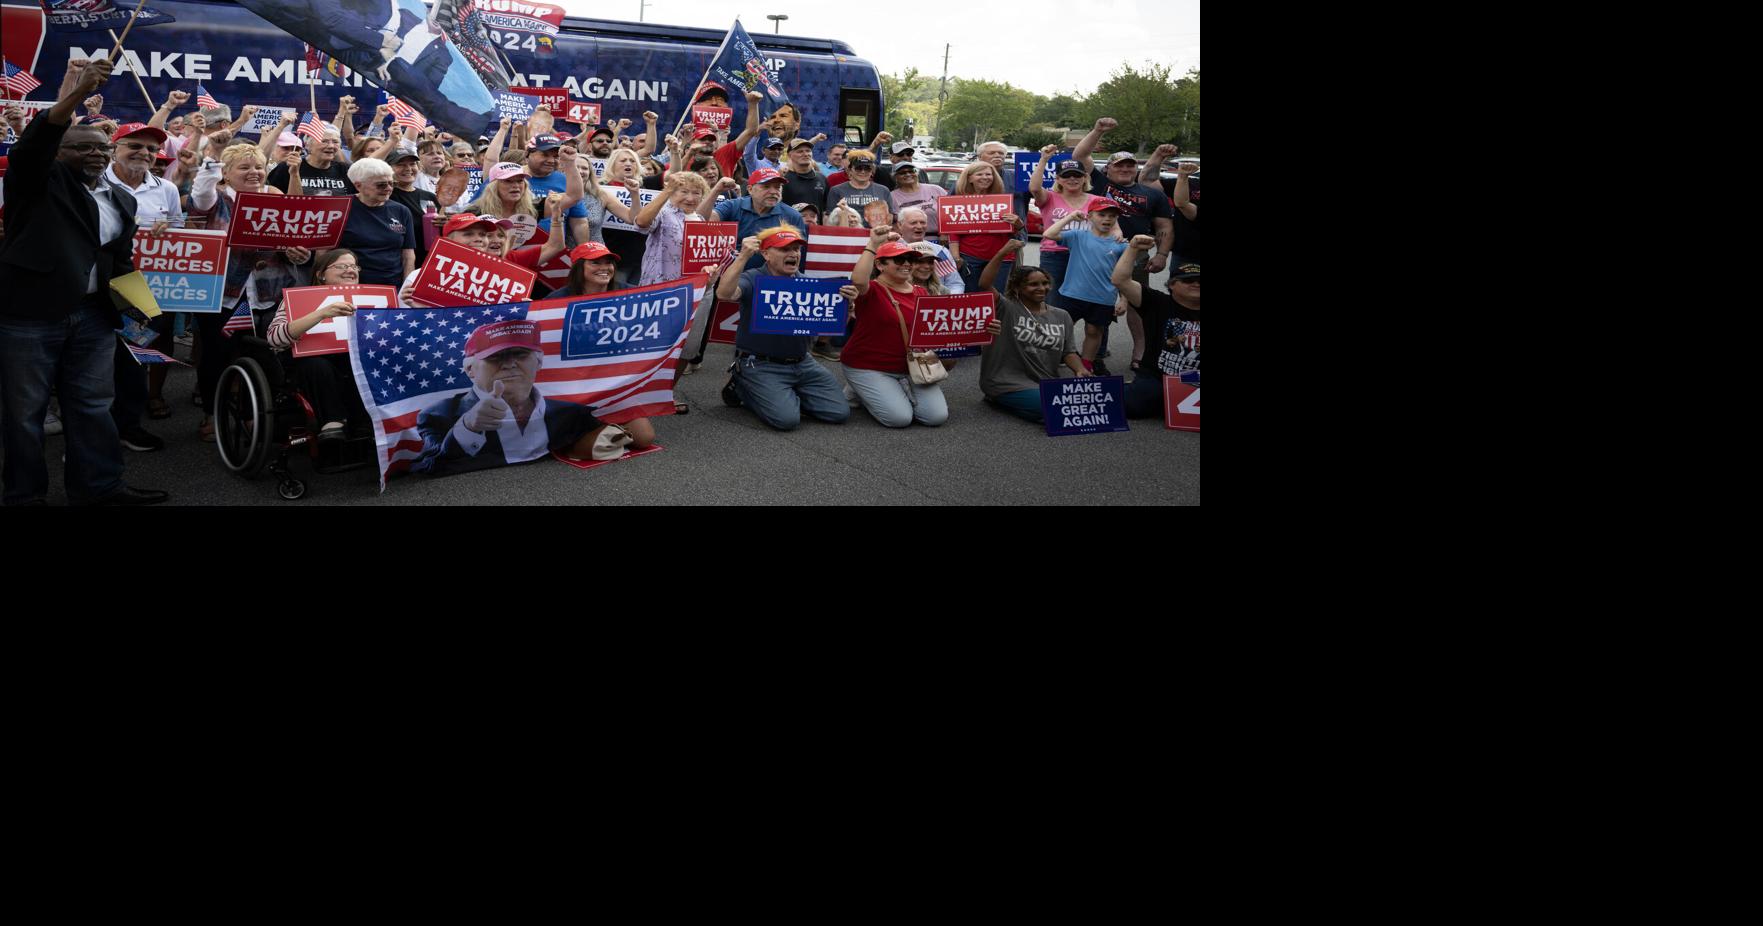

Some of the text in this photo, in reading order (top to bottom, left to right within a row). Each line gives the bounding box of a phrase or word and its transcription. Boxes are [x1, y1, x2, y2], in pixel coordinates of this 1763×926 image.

[474, 0, 553, 17] RUMP
[484, 16, 522, 27] AMERICA
[489, 30, 537, 53] 024
[562, 76, 669, 102] AGAIN!
[494, 98, 534, 110] AMERICA
[500, 93, 525, 103] MAKE
[500, 105, 529, 115] GREAT
[695, 110, 731, 120] TRUMP
[301, 178, 345, 189] WANTED
[241, 206, 343, 224] TRUMP
[942, 203, 1008, 214] TRUMP
[949, 212, 1000, 222] VANCE
[250, 221, 330, 234] VANCE
[132, 238, 203, 257] RUMP
[687, 235, 736, 248] TRUMP
[692, 247, 723, 259] VANC
[139, 256, 214, 273] PRICES
[147, 275, 190, 288] ALA
[434, 254, 526, 296] TRUMP
[150, 287, 208, 300] RICES
[427, 283, 444, 292] MAKE
[445, 288, 471, 301] AMERICA
[439, 272, 513, 305] VANCE
[760, 289, 844, 307] TRUMP
[581, 296, 681, 325] TRUMP
[769, 303, 835, 317] VANCE
[919, 306, 993, 322] TRUMP
[927, 320, 986, 332] VANCE
[596, 320, 661, 346] 2024
[1062, 382, 1102, 394] MAKE
[1052, 392, 1114, 406] AMERICA
[1061, 403, 1107, 416] GREAT
[1063, 414, 1110, 428] AGAIN!
